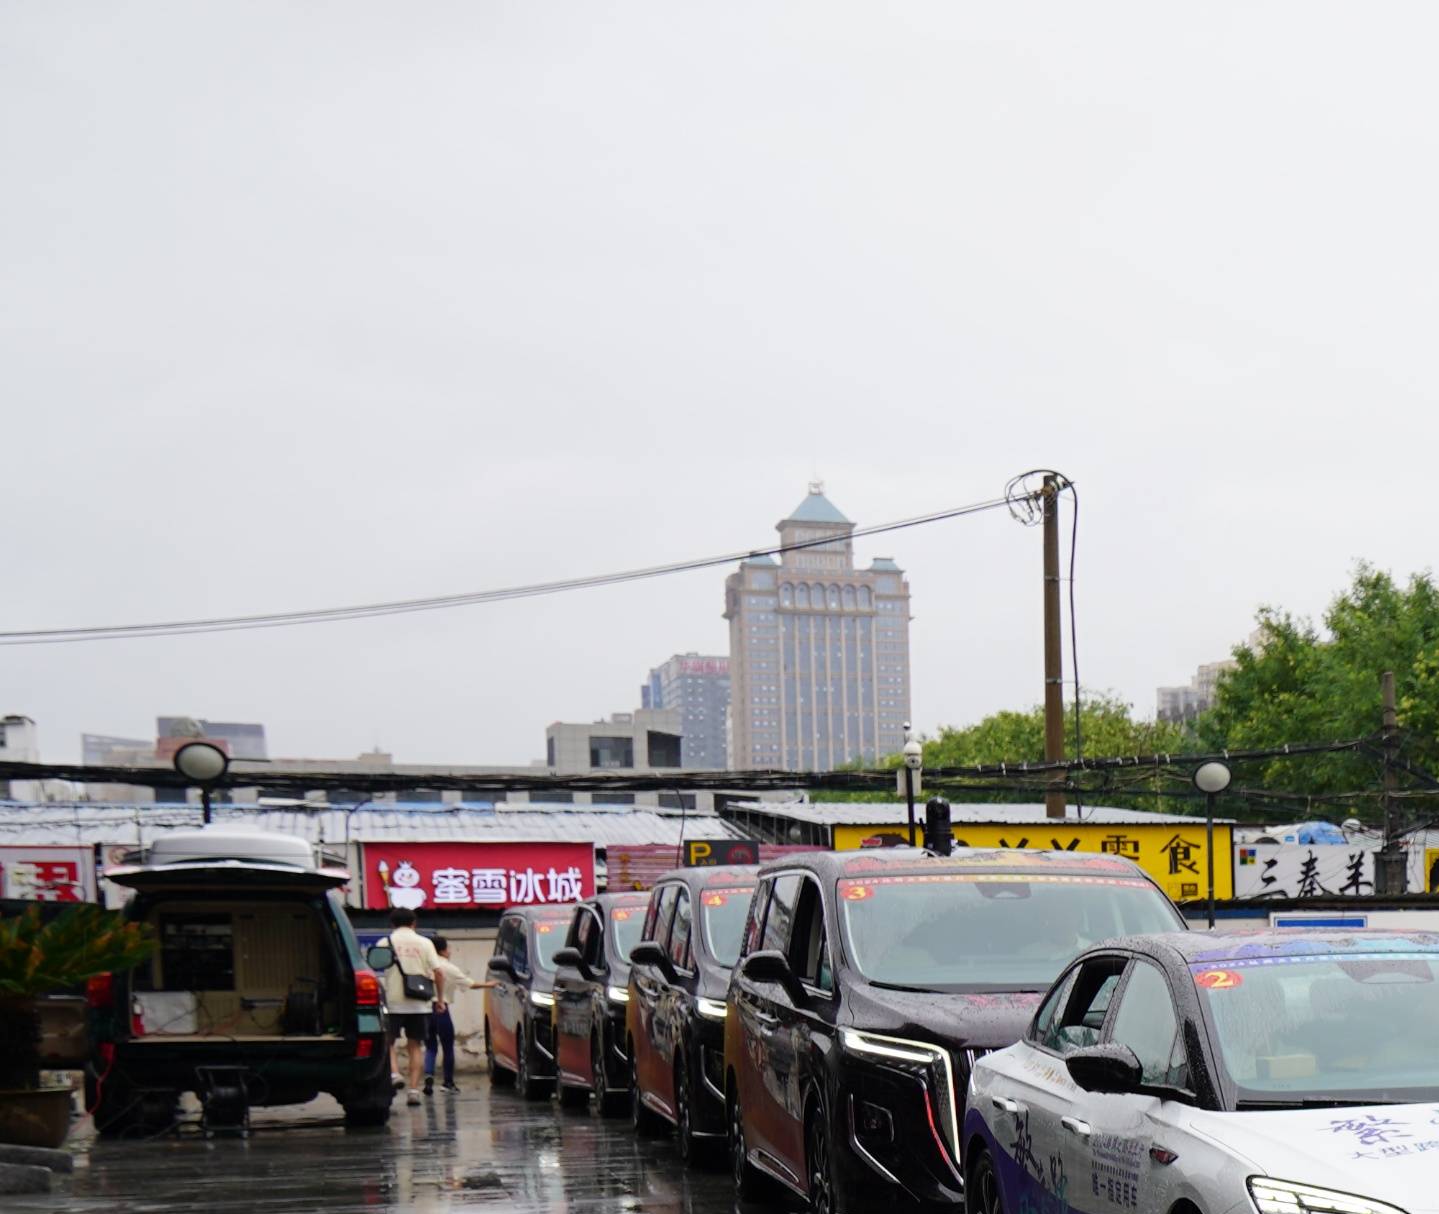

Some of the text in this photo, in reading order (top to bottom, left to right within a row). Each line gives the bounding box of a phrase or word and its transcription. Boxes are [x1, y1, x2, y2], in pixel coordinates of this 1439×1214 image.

[690, 842, 712, 865] P
[432, 867, 583, 904] 蜜雪冰城
[848, 886, 866, 900] 3
[1204, 970, 1234, 988] 2
